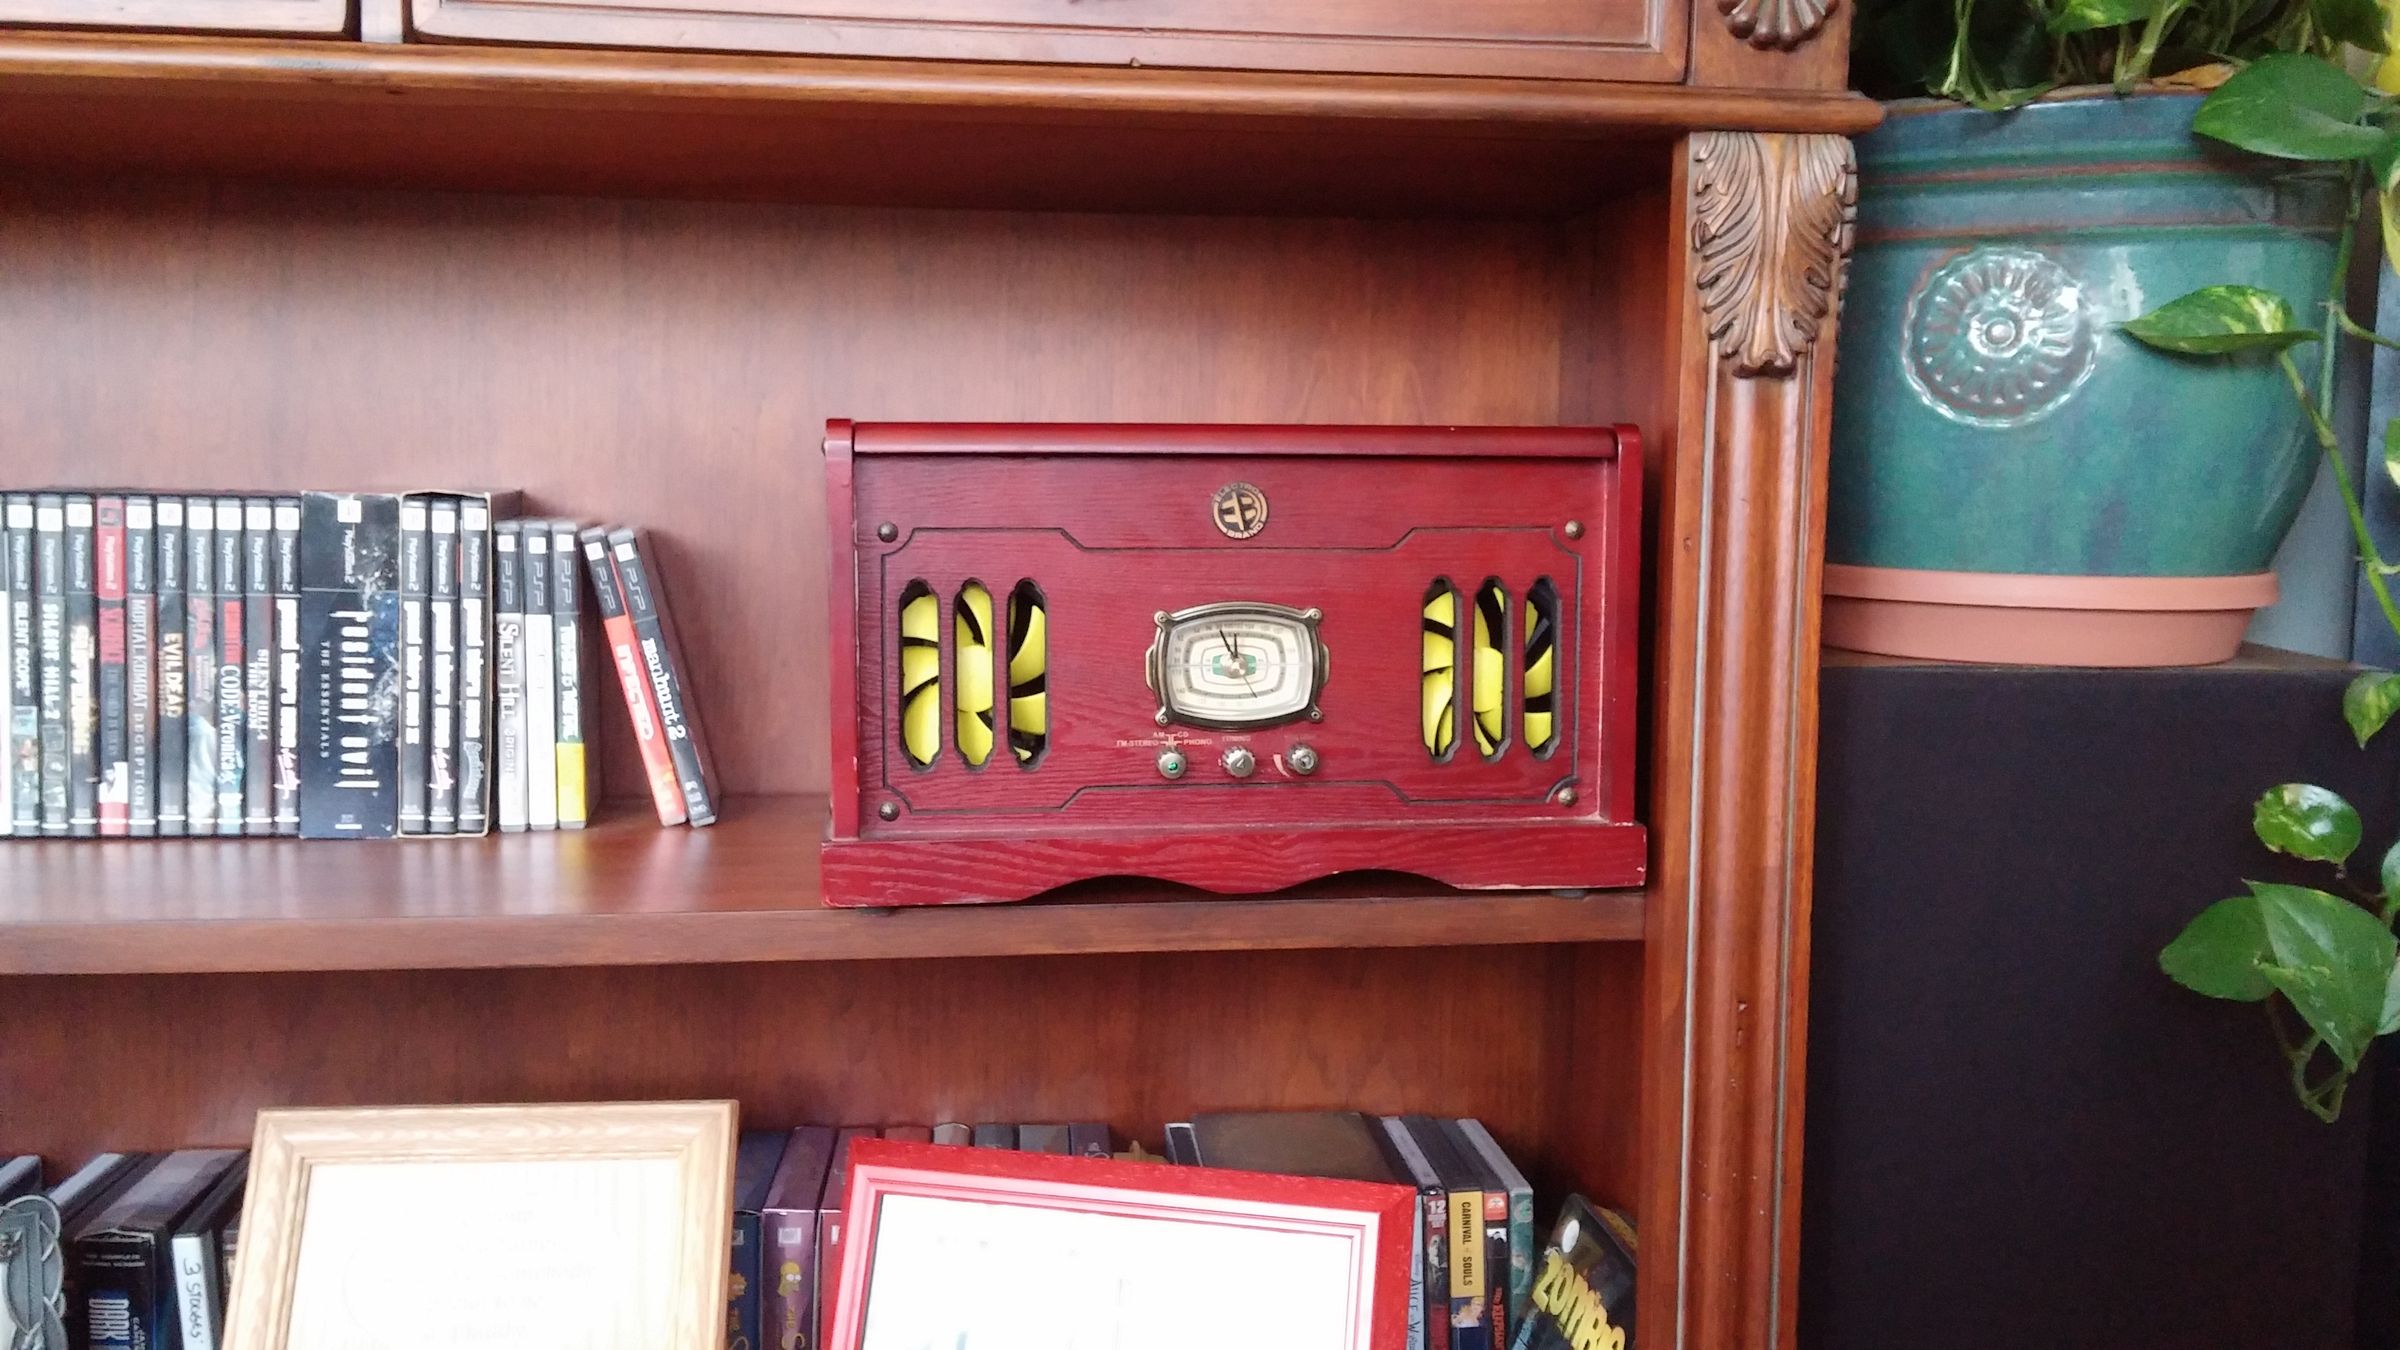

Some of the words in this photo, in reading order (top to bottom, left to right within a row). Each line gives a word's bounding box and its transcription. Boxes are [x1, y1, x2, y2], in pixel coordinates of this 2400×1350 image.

[134, 582, 146, 591] 2
[165, 579, 177, 588] 2
[196, 582, 207, 591] 2
[224, 583, 236, 592] 2
[254, 583, 265, 591] 2
[282, 583, 294, 592] 2
[408, 582, 419, 592] 2
[438, 584, 449, 594] 2
[470, 582, 481, 591] 2
[502, 559, 513, 605] PSP
[533, 561, 544, 607] PSP
[561, 559, 572, 604] PSP
[597, 567, 616, 610] PSP
[626, 567, 646, 611] PSP
[14, 601, 29, 645] SILENT
[42, 604, 60, 661] SILENT
[132, 599, 147, 655] MORTAL
[16, 647, 30, 689] SCOPE
[163, 633, 183, 671] EVIL
[320, 640, 330, 666] THE
[328, 610, 379, 725] resident
[498, 622, 519, 677] SILENT
[43, 666, 60, 706] HILL
[133, 656, 148, 709] KOMBAT
[164, 672, 184, 718] DEAD
[247, 662, 258, 687] THE
[257, 649, 269, 699] SILENT
[641, 637, 681, 726] manhunt
[667, 724, 687, 741] 2
[257, 700, 269, 730] HILL
[320, 673, 331, 758] ESSENTIALS
[498, 683, 520, 720] HILL
[133, 713, 145, 806] DECEPTION
[333, 736, 380, 788] evil
[1429, 1200, 1447, 1215] 12
[1461, 1201, 1473, 1245] CARNIVAL
[183, 1257, 201, 1276] 3
[1462, 1256, 1473, 1286] SOULS
[88, 1298, 130, 1340] DARK
